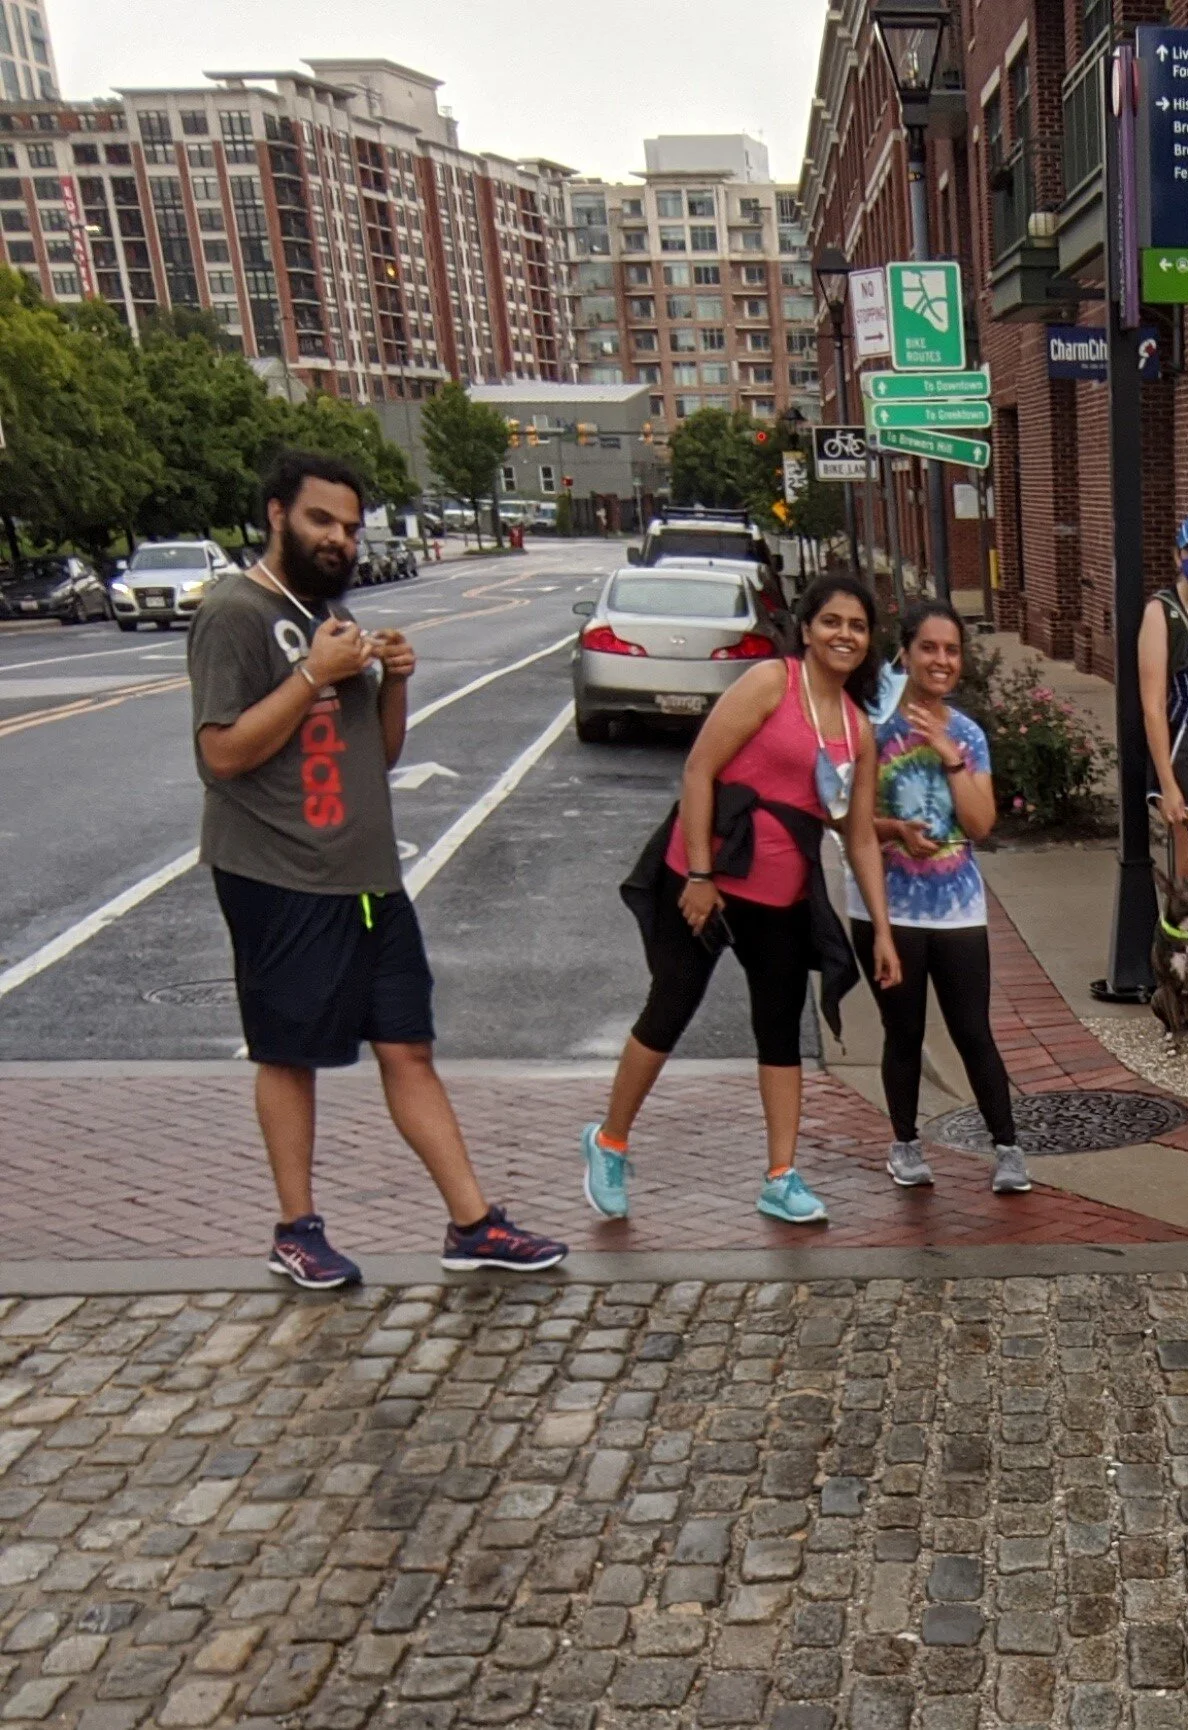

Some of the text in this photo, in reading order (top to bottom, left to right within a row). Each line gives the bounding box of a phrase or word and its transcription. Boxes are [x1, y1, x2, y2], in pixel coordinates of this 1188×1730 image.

[860, 280, 875, 298] NO
[905, 337, 927, 349] BIKE
[906, 350, 942, 362] ROUTES
[823, 463, 867, 475] BIKE LAN
